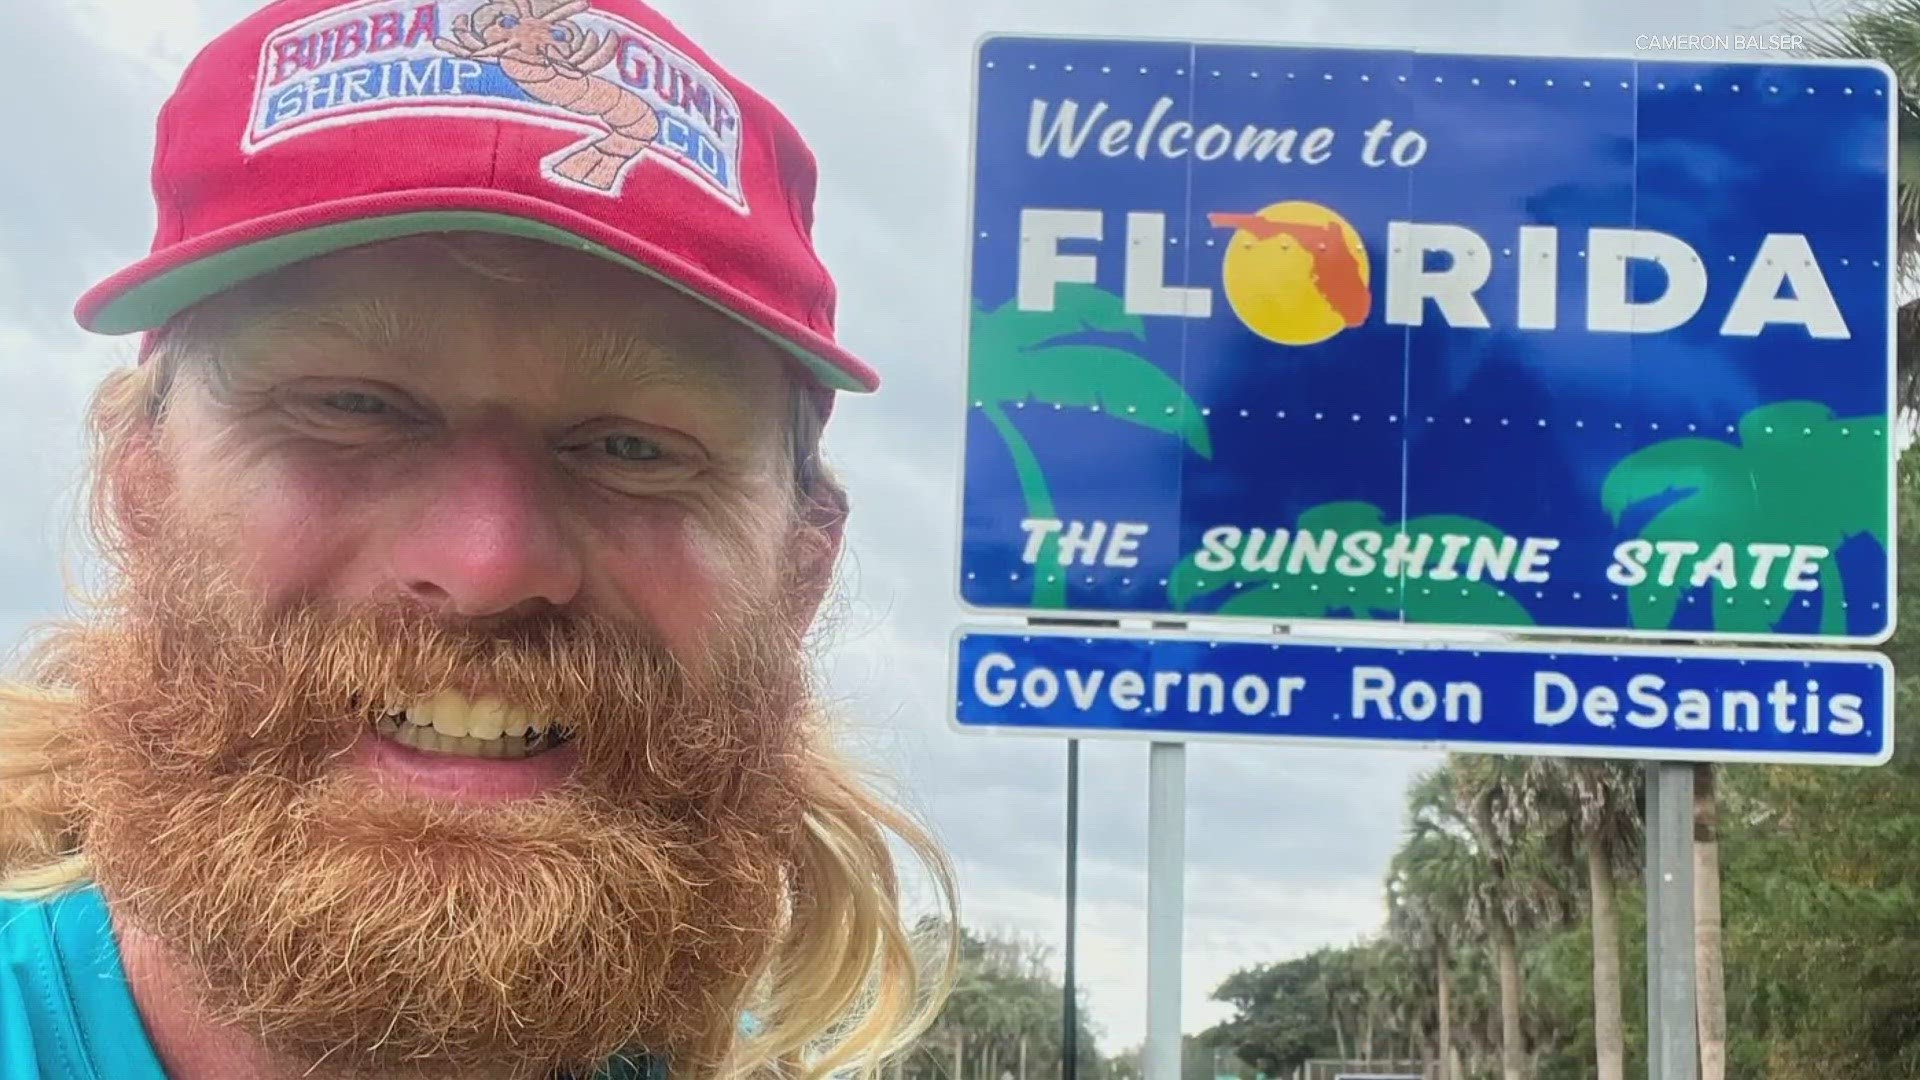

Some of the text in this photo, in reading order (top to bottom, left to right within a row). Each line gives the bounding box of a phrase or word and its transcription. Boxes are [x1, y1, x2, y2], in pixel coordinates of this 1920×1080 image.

[270, 2, 737, 139] BUBBA GUMP
[274, 59, 719, 174] SHRIMP CO
[1026, 97, 1428, 167] Welcome to
[1016, 200, 1851, 346] FLORIDA
[1020, 519, 1830, 592] THE SUNSHINE STATE
[974, 652, 1865, 736] Governor Ron DeSantis
